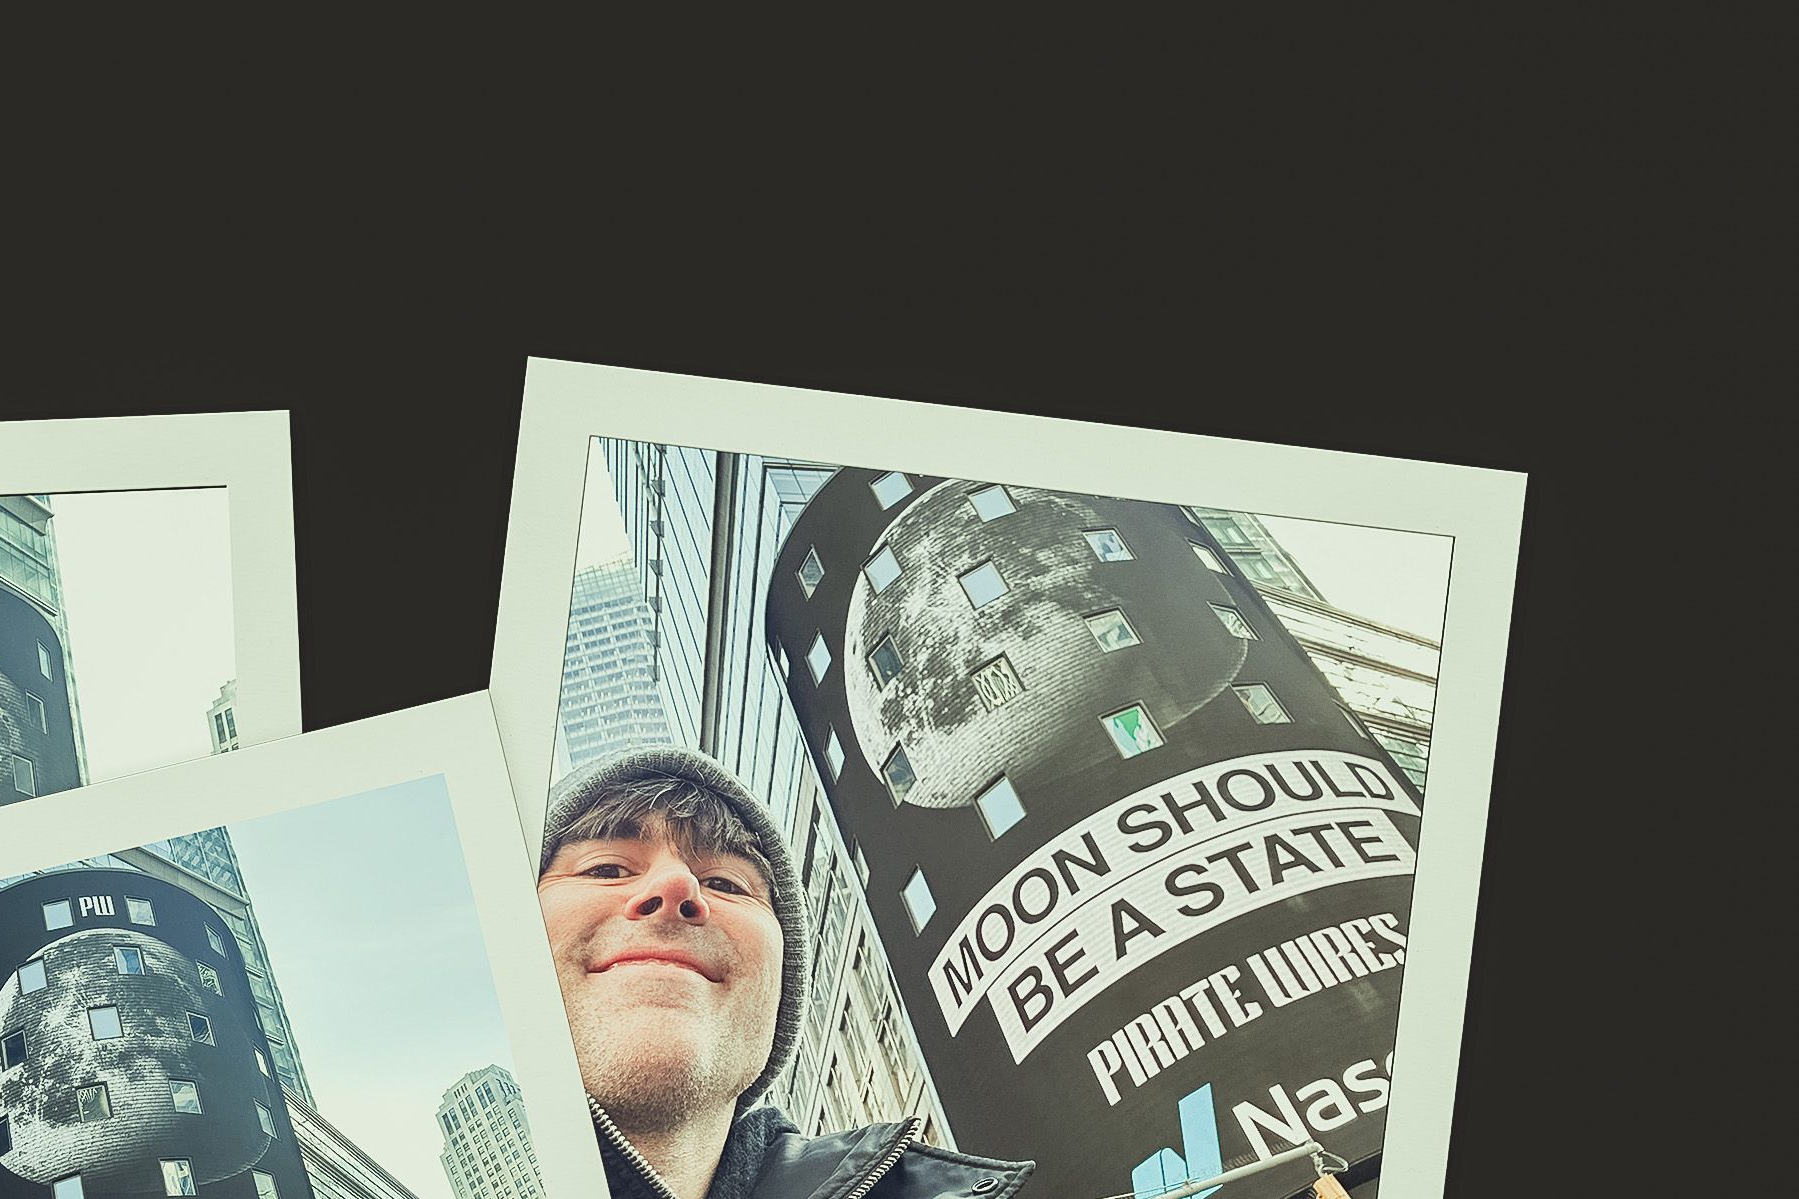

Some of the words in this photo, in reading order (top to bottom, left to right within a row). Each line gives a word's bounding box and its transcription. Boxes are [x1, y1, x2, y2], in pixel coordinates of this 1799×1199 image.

[943, 830, 1112, 1009] MOON
[1116, 759, 1395, 854] SHOULD
[1006, 928, 1100, 1034] BE
[1110, 897, 1167, 962] A
[1164, 819, 1401, 918] STATE
[1086, 964, 1265, 1107] PIRATE
[1246, 912, 1407, 1009] WIRES
[1233, 1051, 1394, 1161] Nas
